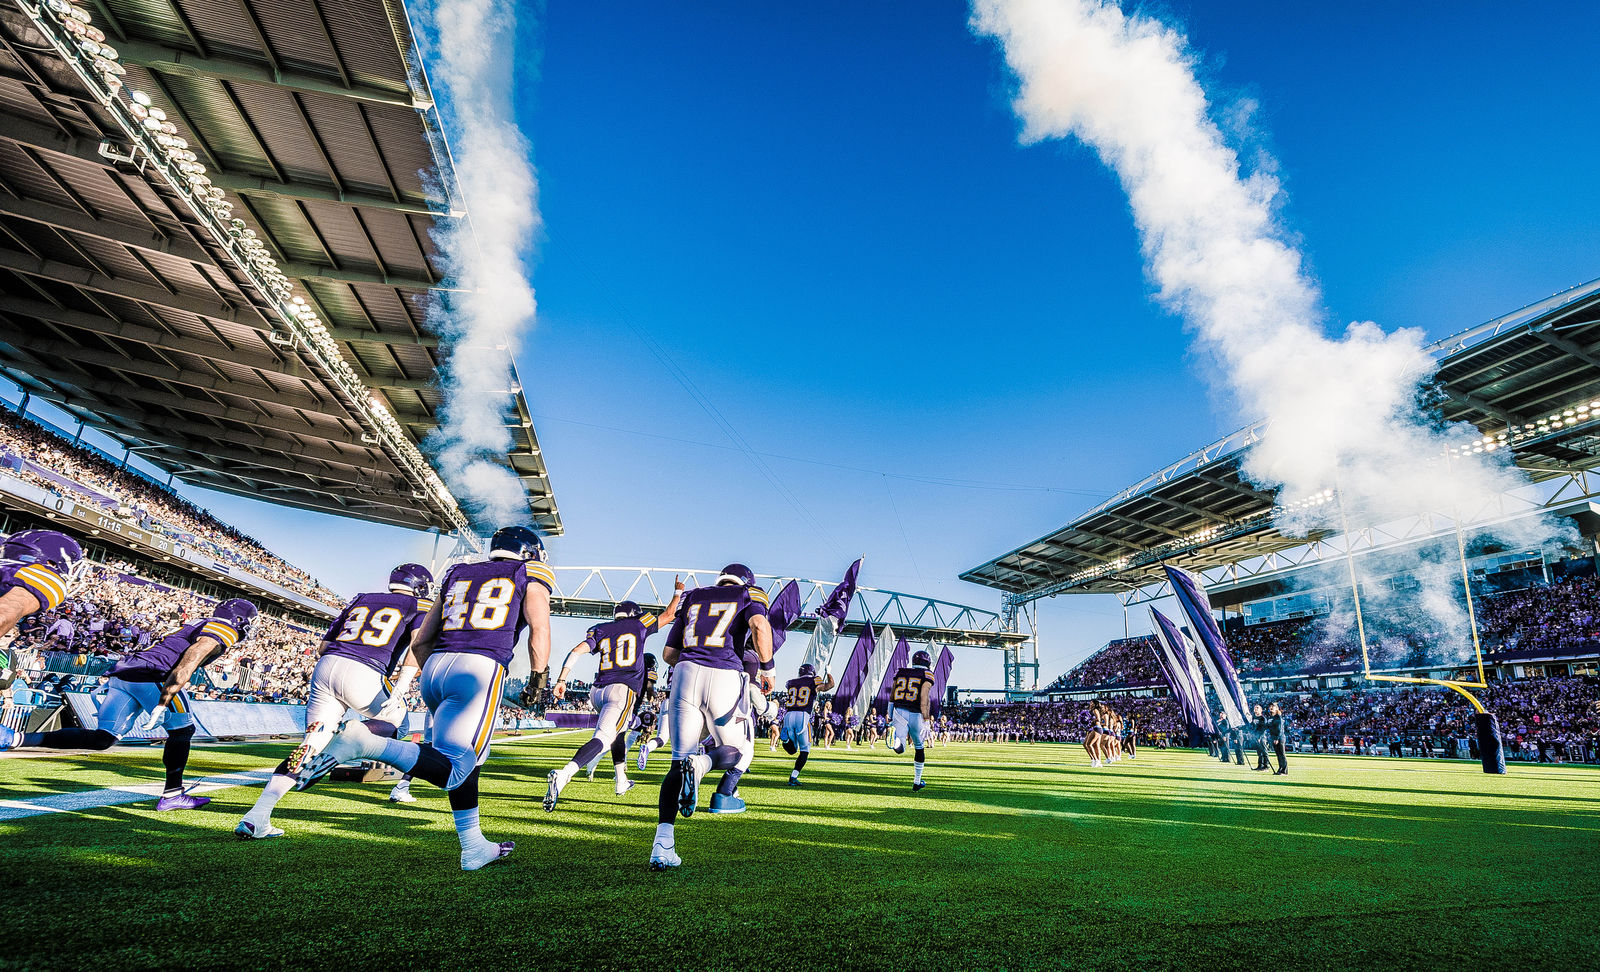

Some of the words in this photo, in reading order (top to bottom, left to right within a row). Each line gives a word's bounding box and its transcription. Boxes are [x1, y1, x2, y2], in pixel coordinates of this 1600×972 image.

[55, 499, 64, 510] 0
[98, 516, 122, 533] 11:15
[158, 540, 168, 550] 20
[180, 548, 186, 558] 0
[442, 577, 516, 631] 48
[683, 602, 738, 648] 17
[599, 633, 637, 671] 10
[785, 686, 811, 707] 39
[893, 676, 922, 701] 25
